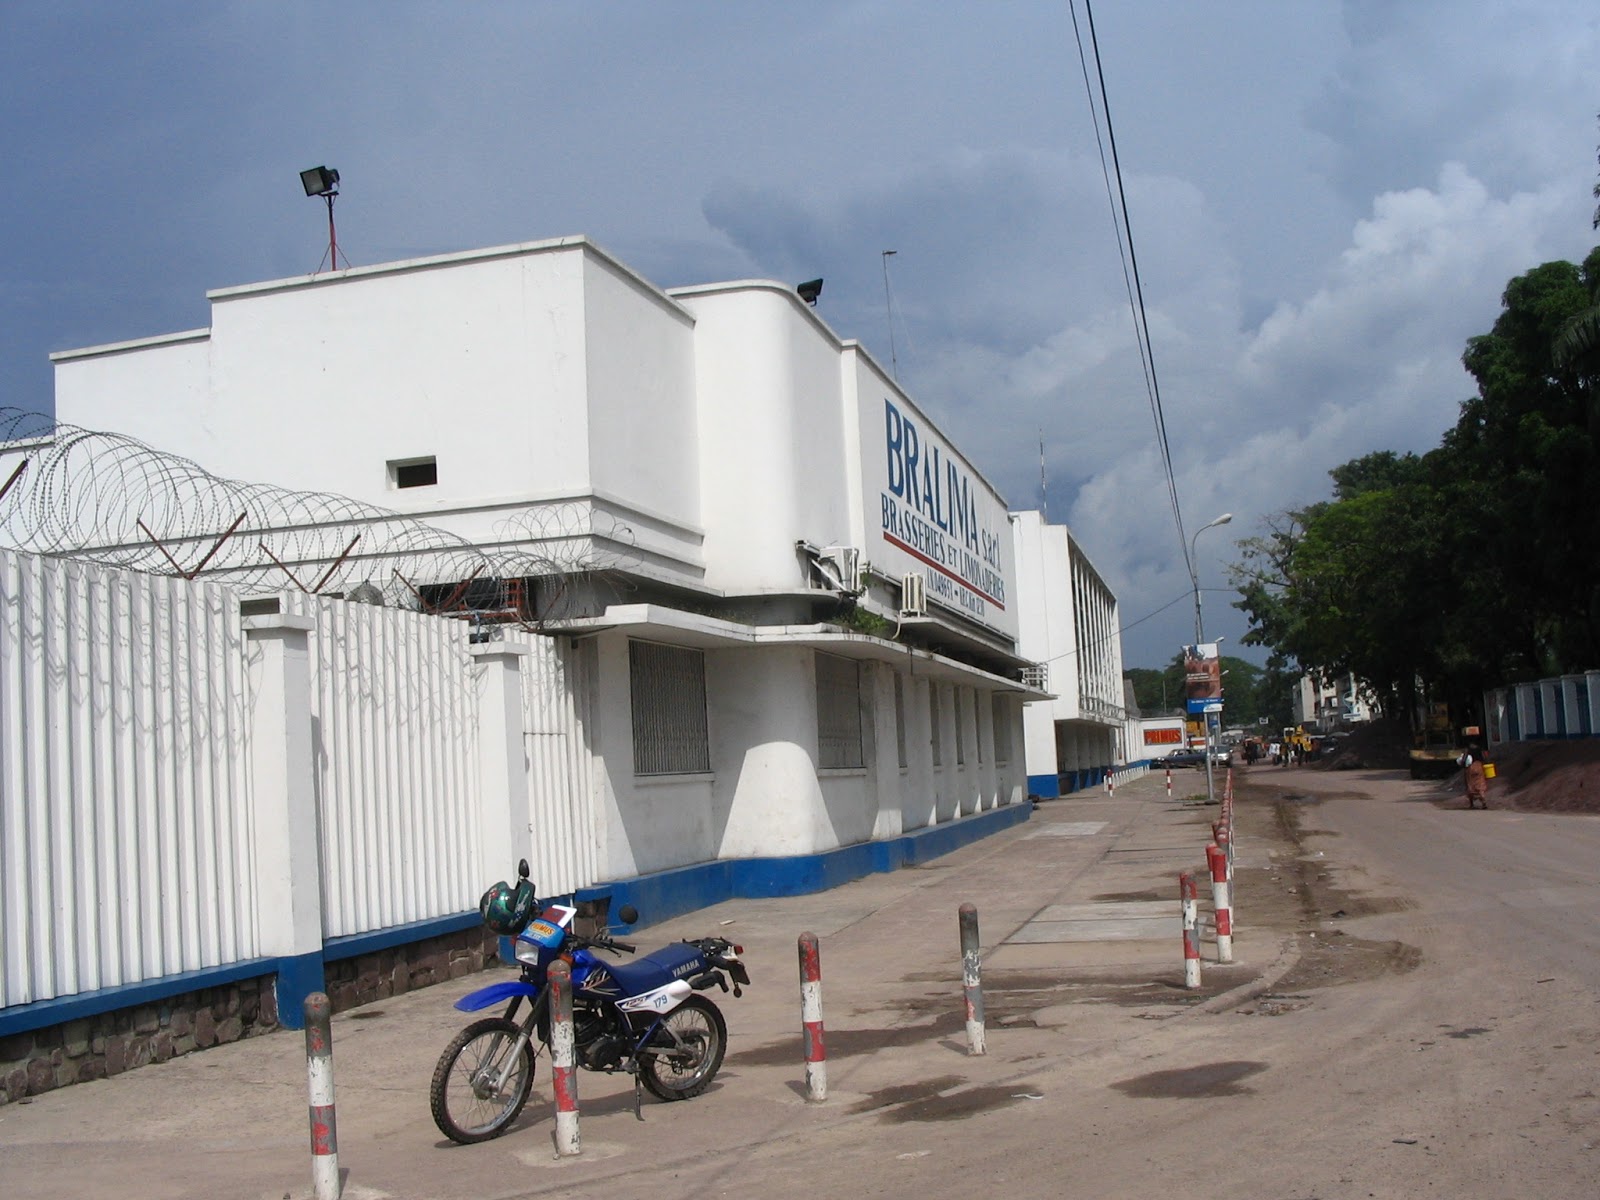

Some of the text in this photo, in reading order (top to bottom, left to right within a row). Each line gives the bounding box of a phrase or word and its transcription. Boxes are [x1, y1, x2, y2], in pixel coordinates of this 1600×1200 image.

[884, 397, 980, 556] BRALIMA
[881, 492, 946, 565] BRASSERIES
[948, 544, 957, 567] ET
[960, 548, 1005, 604] LIMONADERIES
[671, 959, 700, 978] YAMAHA
[653, 994, 668, 1009] 179
